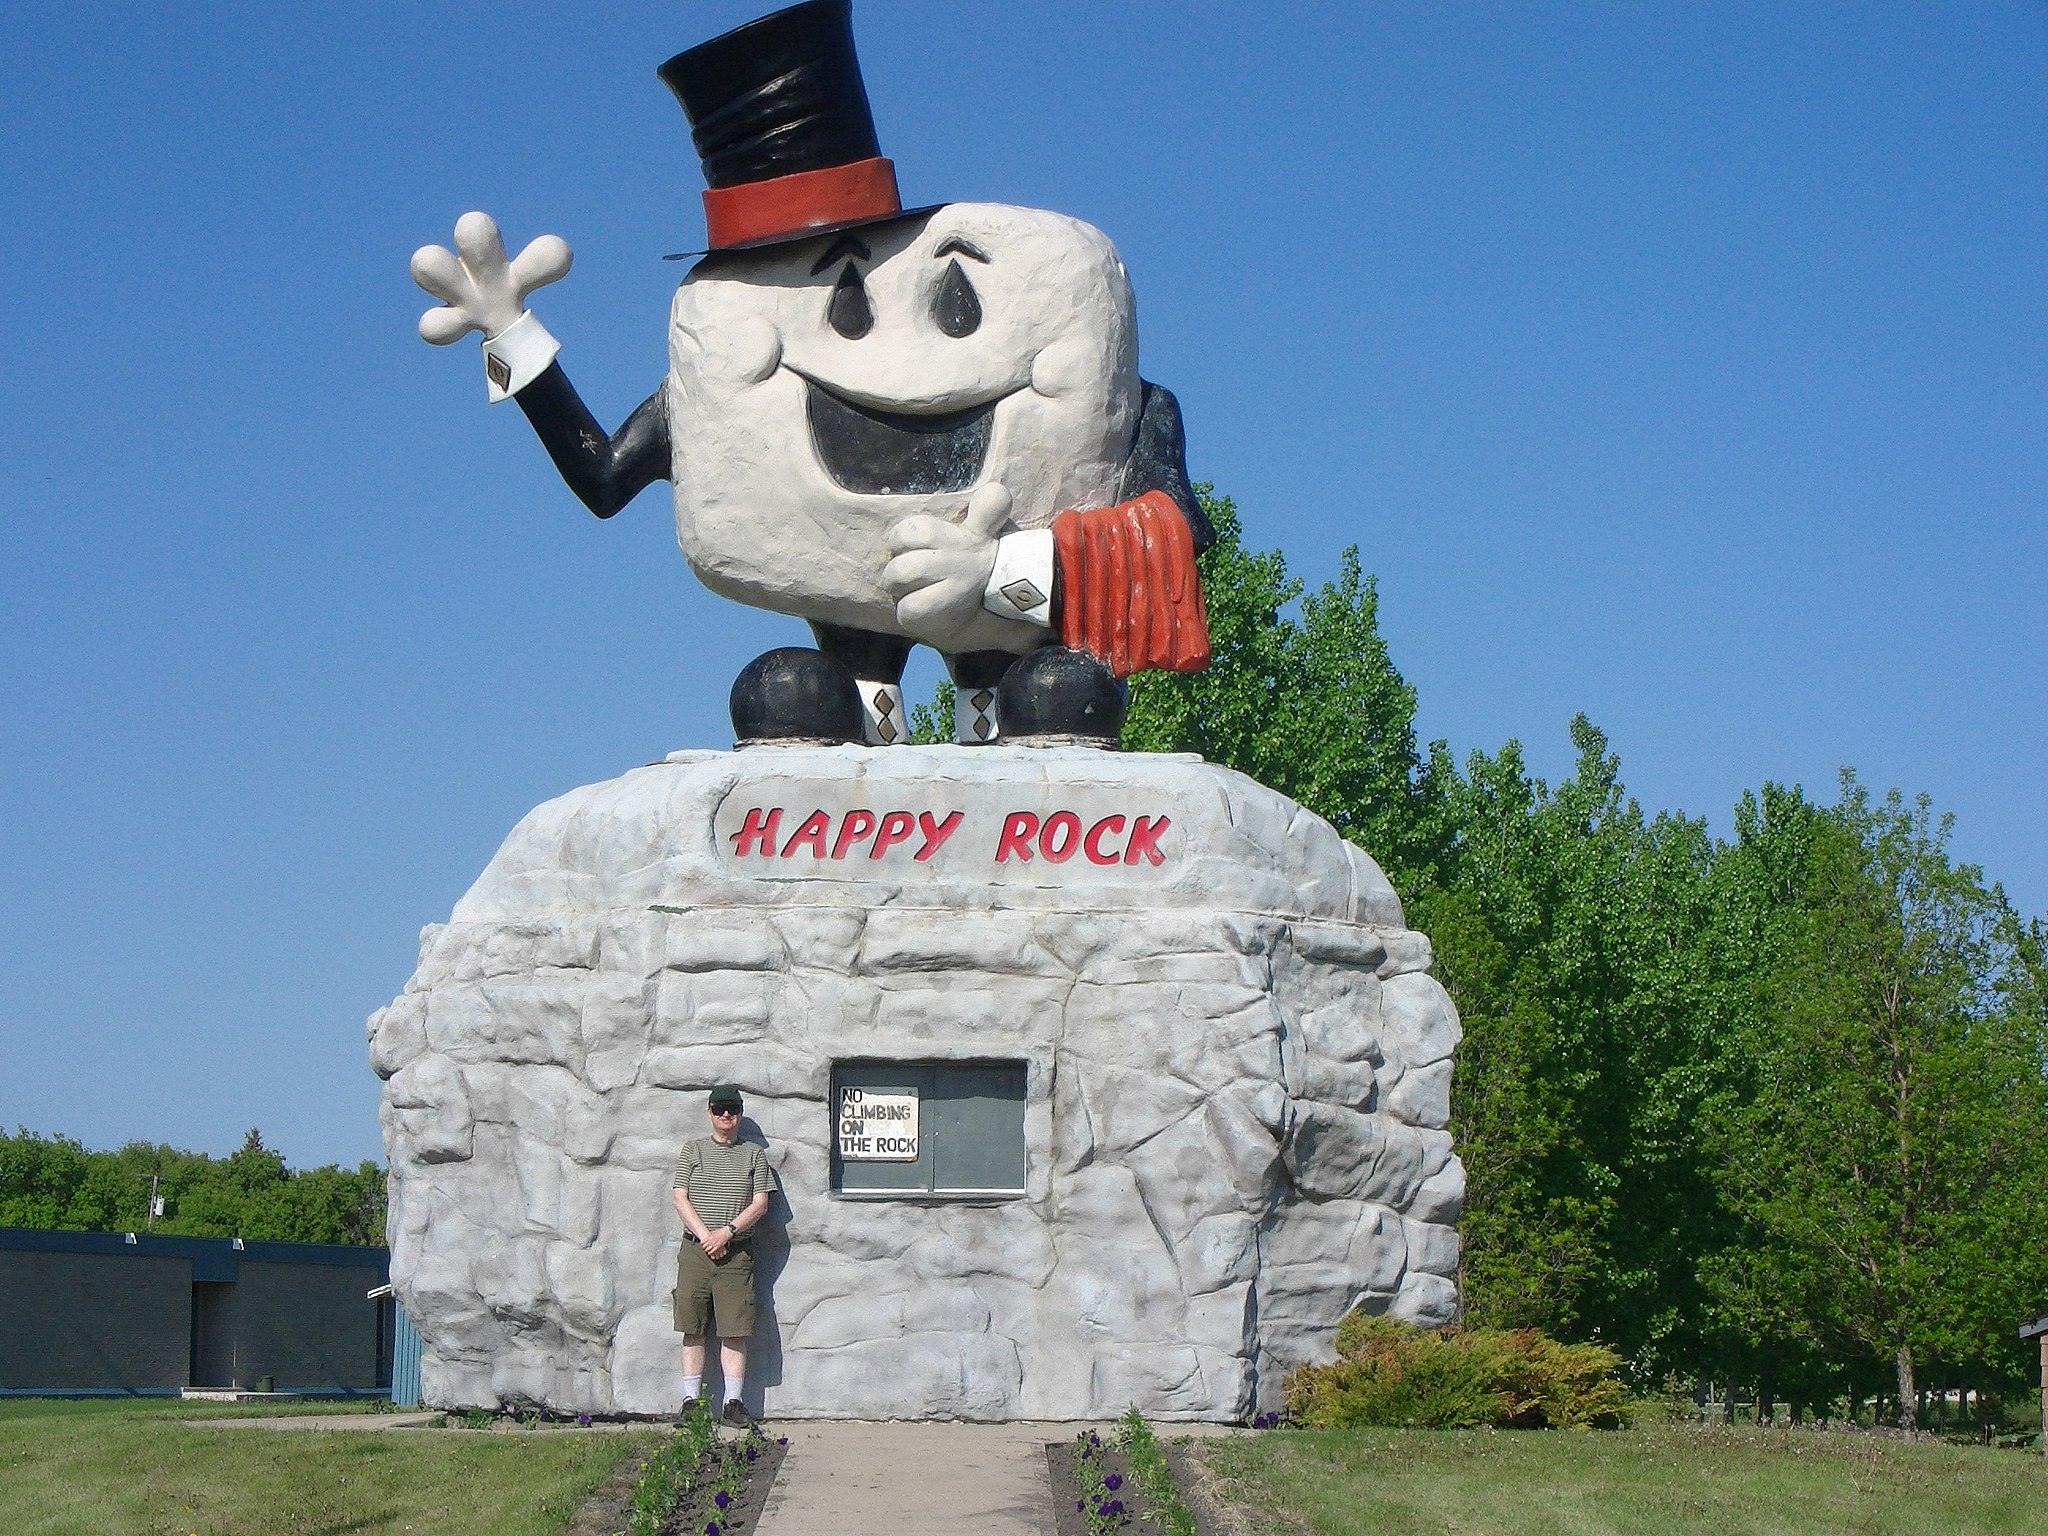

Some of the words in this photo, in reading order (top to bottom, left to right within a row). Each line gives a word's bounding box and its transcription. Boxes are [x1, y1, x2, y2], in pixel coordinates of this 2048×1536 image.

[729, 807, 965, 861] HAPPY
[995, 810, 1171, 866] ROCK
[843, 1088, 863, 1103] NO
[842, 1104, 911, 1120] CLIMBING
[841, 1120, 864, 1135] ON
[840, 1137, 871, 1152] THE
[876, 1137, 916, 1153] ROCK
